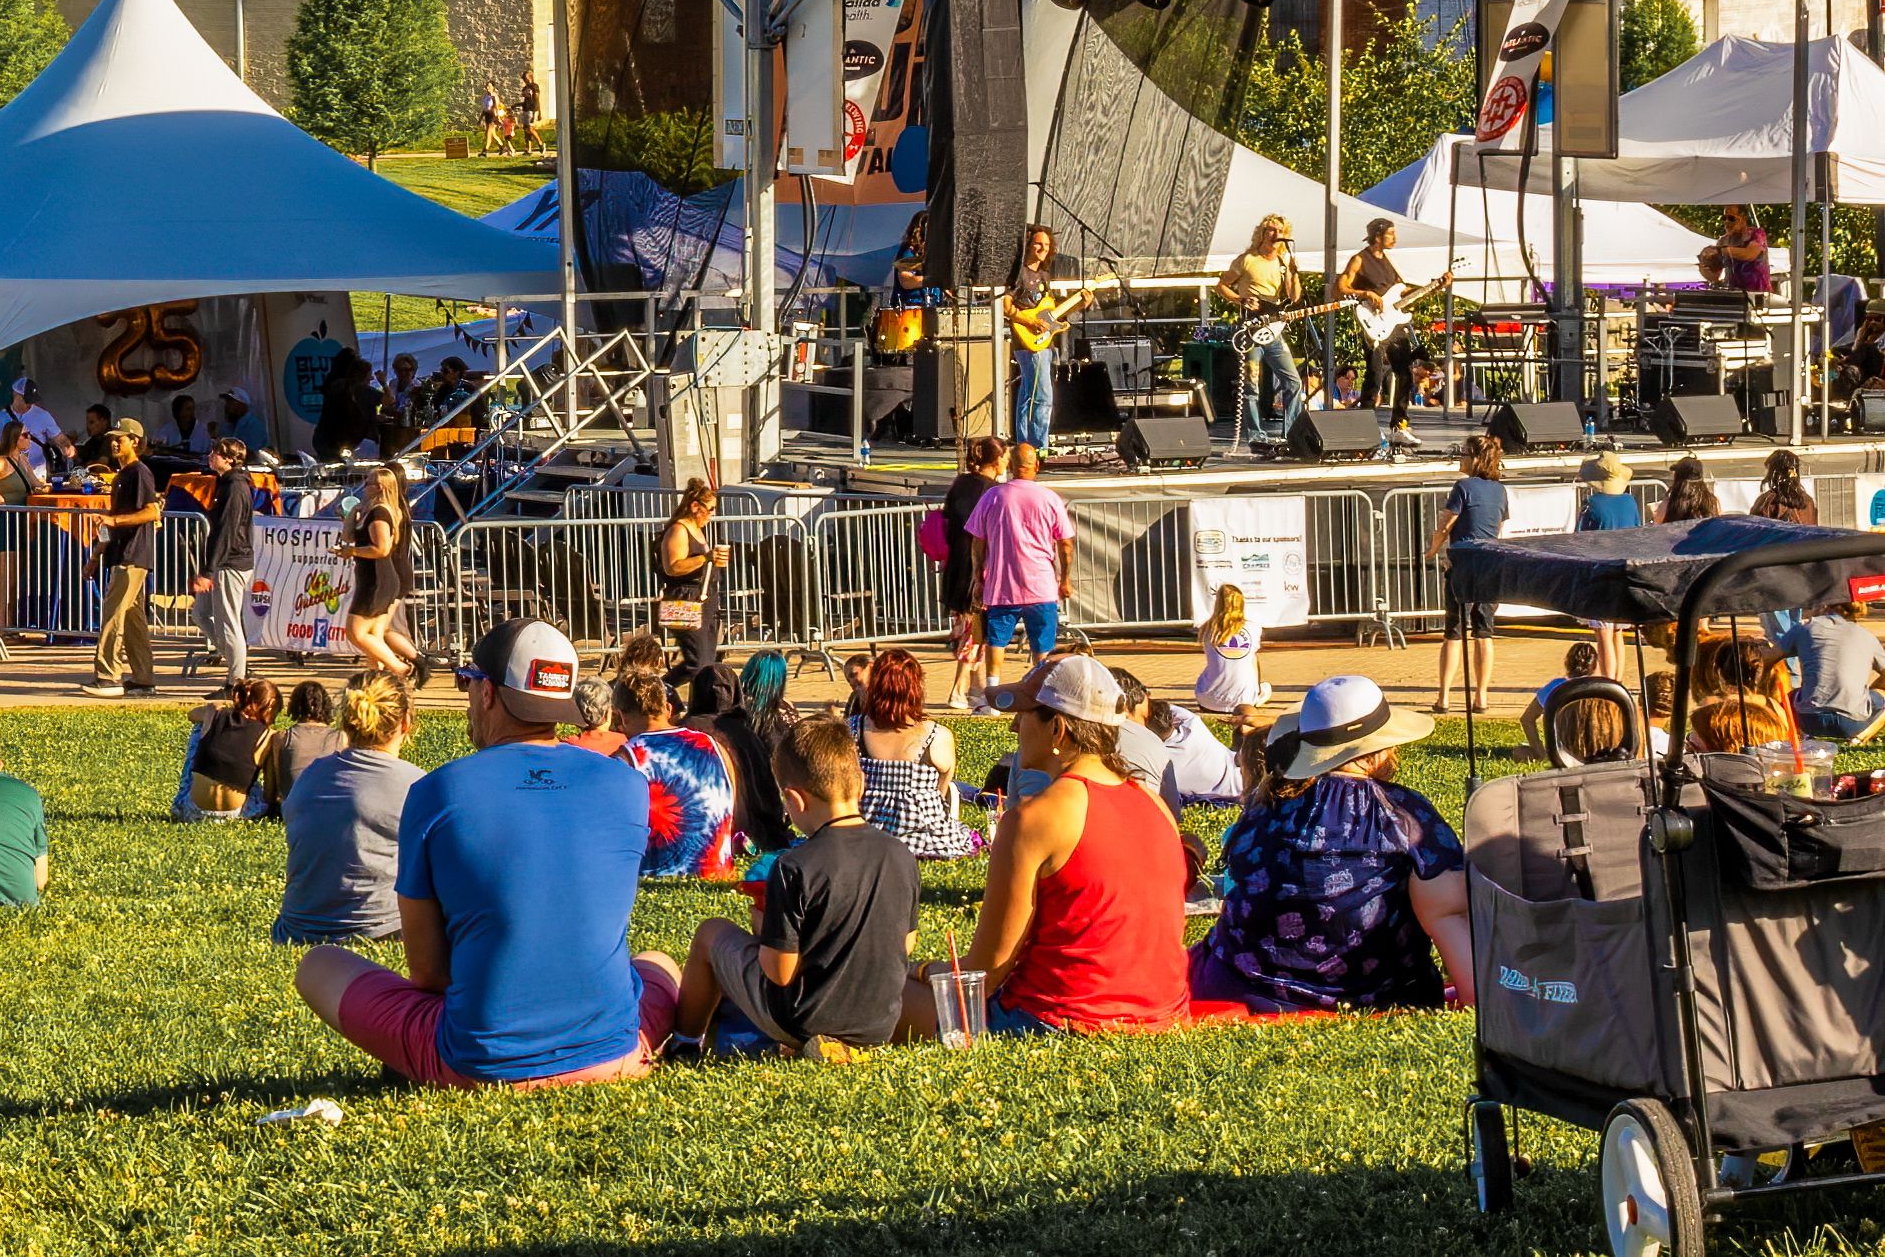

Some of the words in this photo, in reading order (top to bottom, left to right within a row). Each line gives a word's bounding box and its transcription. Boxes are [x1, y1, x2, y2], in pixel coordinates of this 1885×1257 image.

[845, 56, 876, 64] ANTIC
[97, 299, 202, 395] 25
[265, 527, 342, 549] HOSPITA
[286, 623, 313, 638] FOOD
